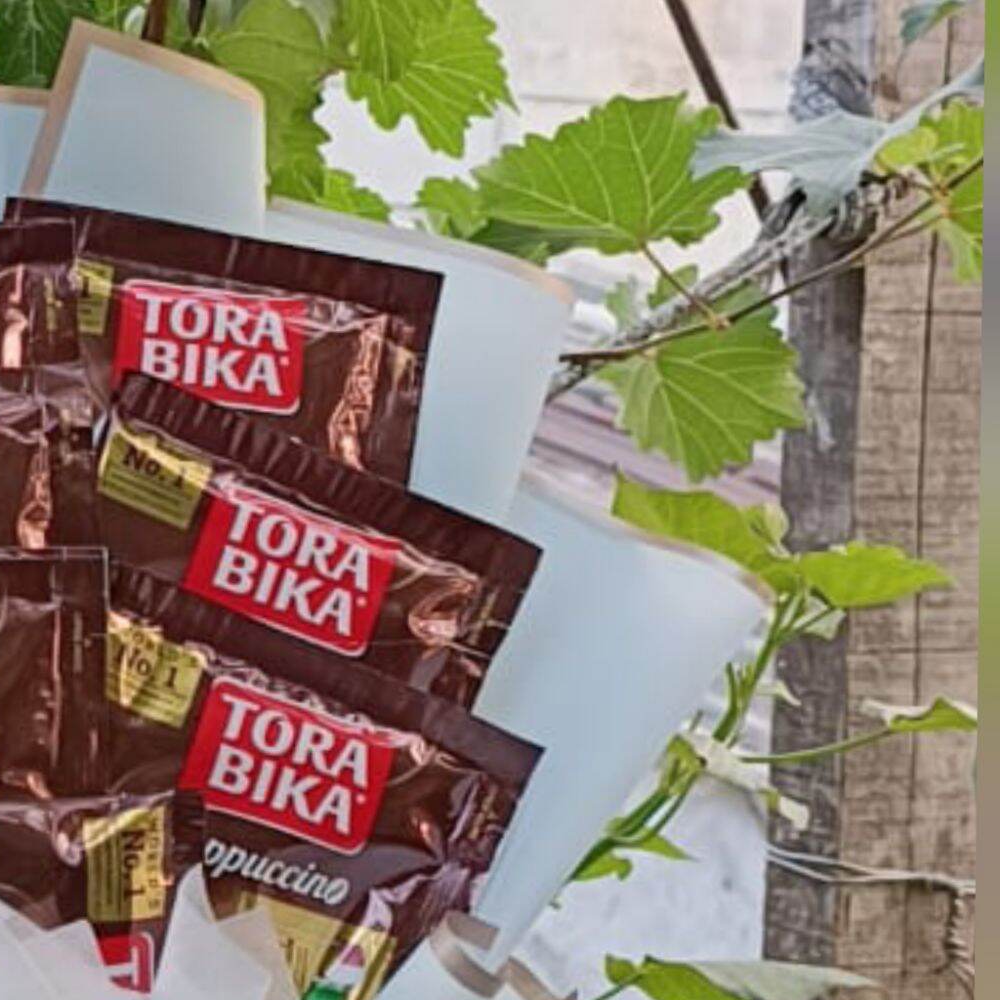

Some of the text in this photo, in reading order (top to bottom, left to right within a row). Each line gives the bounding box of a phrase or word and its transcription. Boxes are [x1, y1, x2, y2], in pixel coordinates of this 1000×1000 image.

[134, 291, 288, 351] TORA
[140, 338, 285, 397] BIKA
[122, 442, 186, 492] No. 1
[224, 497, 372, 591] TORA
[212, 543, 353, 637] BIKA
[220, 693, 369, 788] TORA
[207, 743, 355, 835] BIKA
[123, 828, 147, 880] No.
